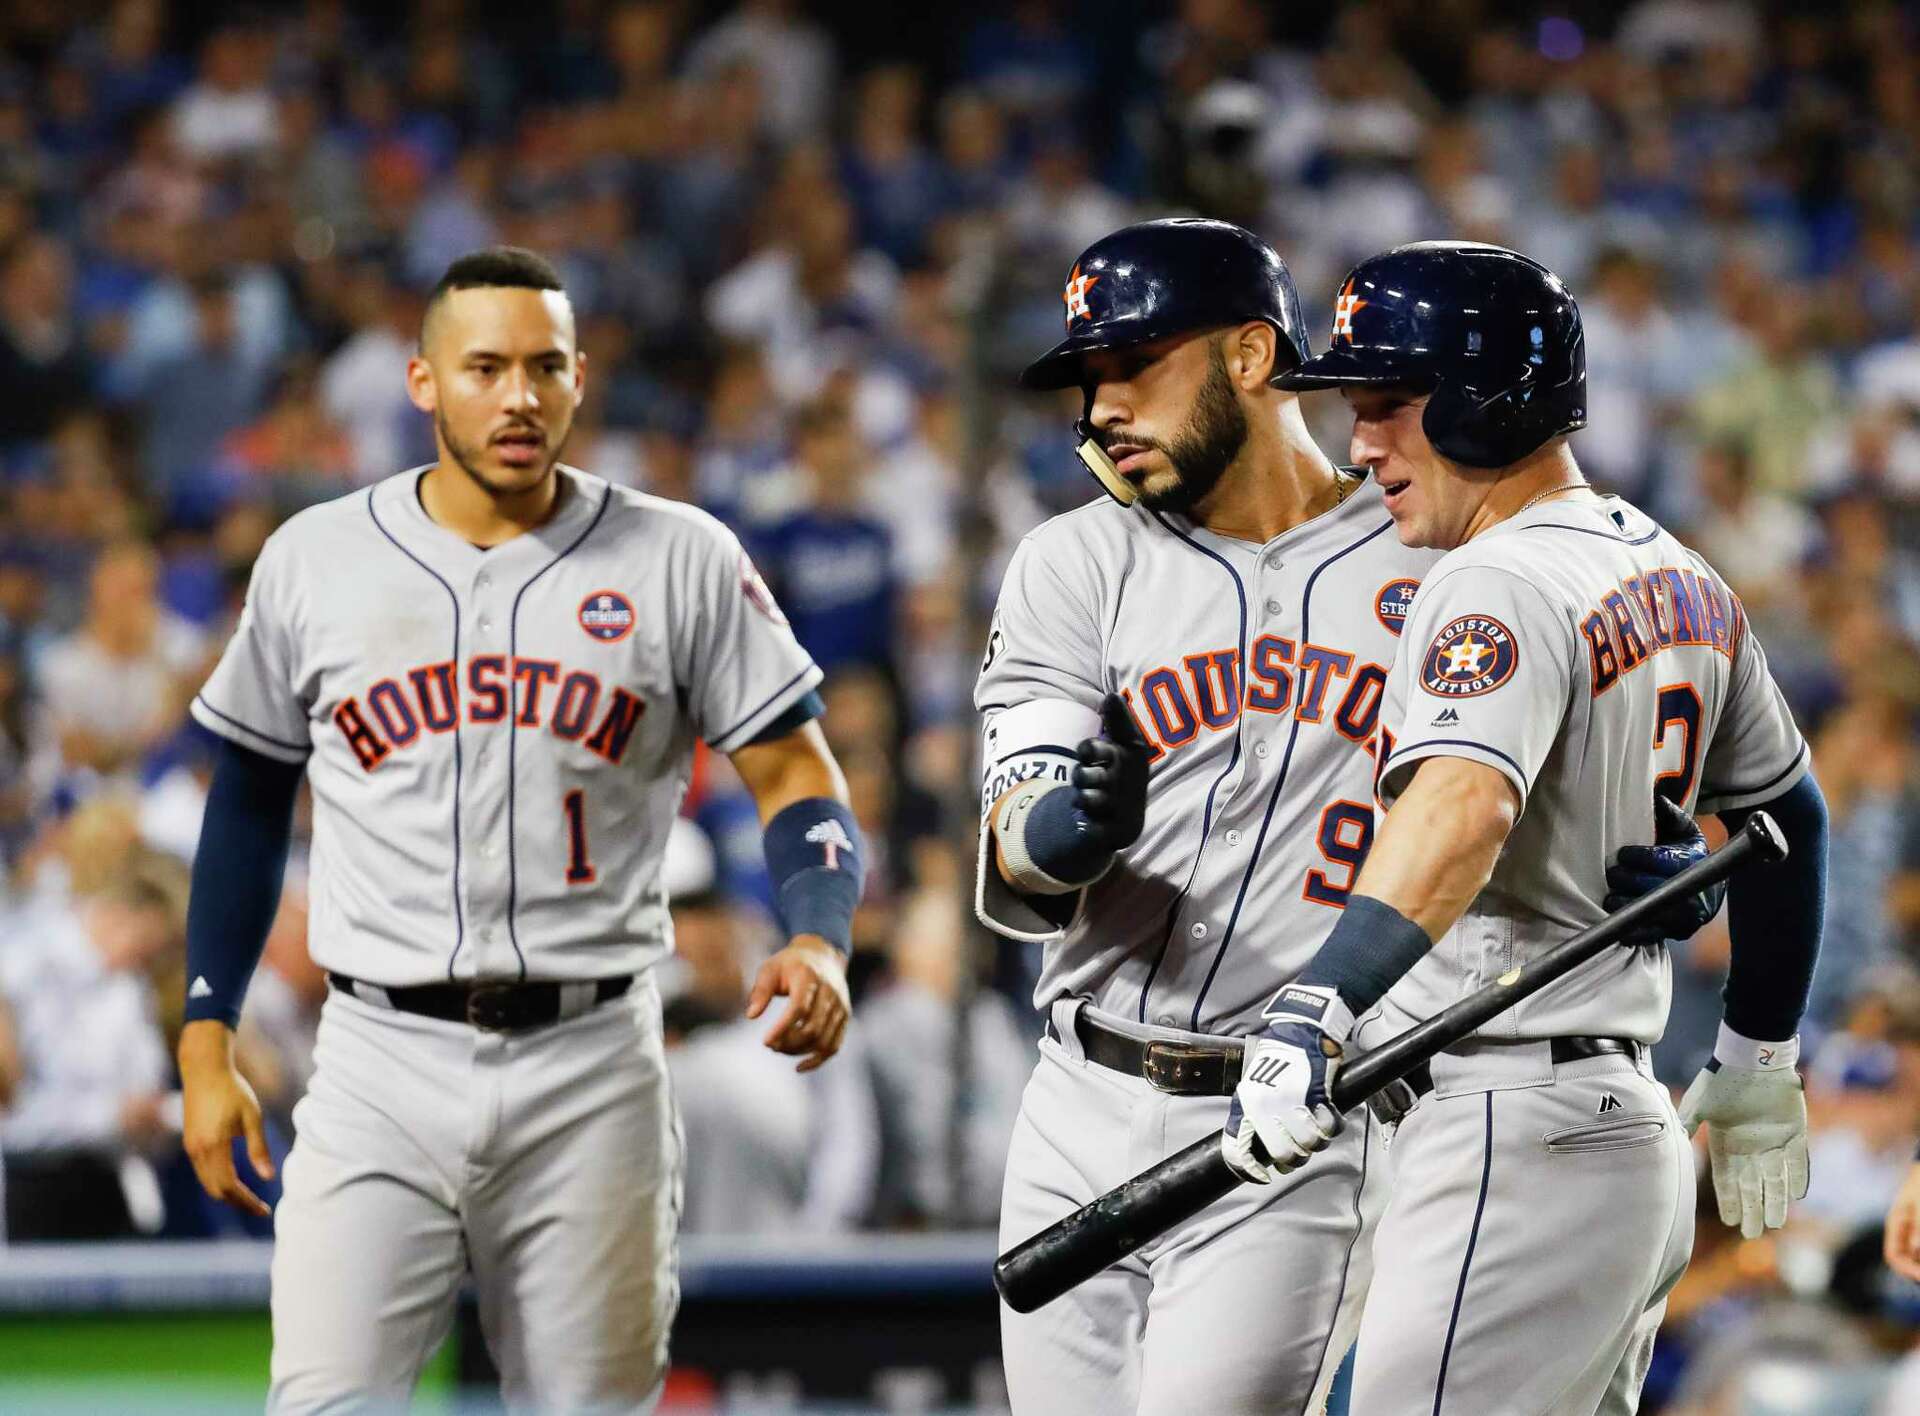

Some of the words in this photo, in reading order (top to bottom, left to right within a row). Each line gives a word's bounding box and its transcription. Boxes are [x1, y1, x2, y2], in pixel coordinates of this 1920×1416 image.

[1066, 275, 1090, 322] H
[1332, 294, 1360, 336] H
[1379, 601, 1408, 615] STR
[1435, 620, 1508, 648] HOUSTON
[1428, 674, 1495, 694] ASTROS
[334, 655, 647, 774] HOUSTON
[1118, 632, 1398, 795] OUSTO
[563, 788, 596, 886] 1
[1302, 799, 1375, 910] 9
